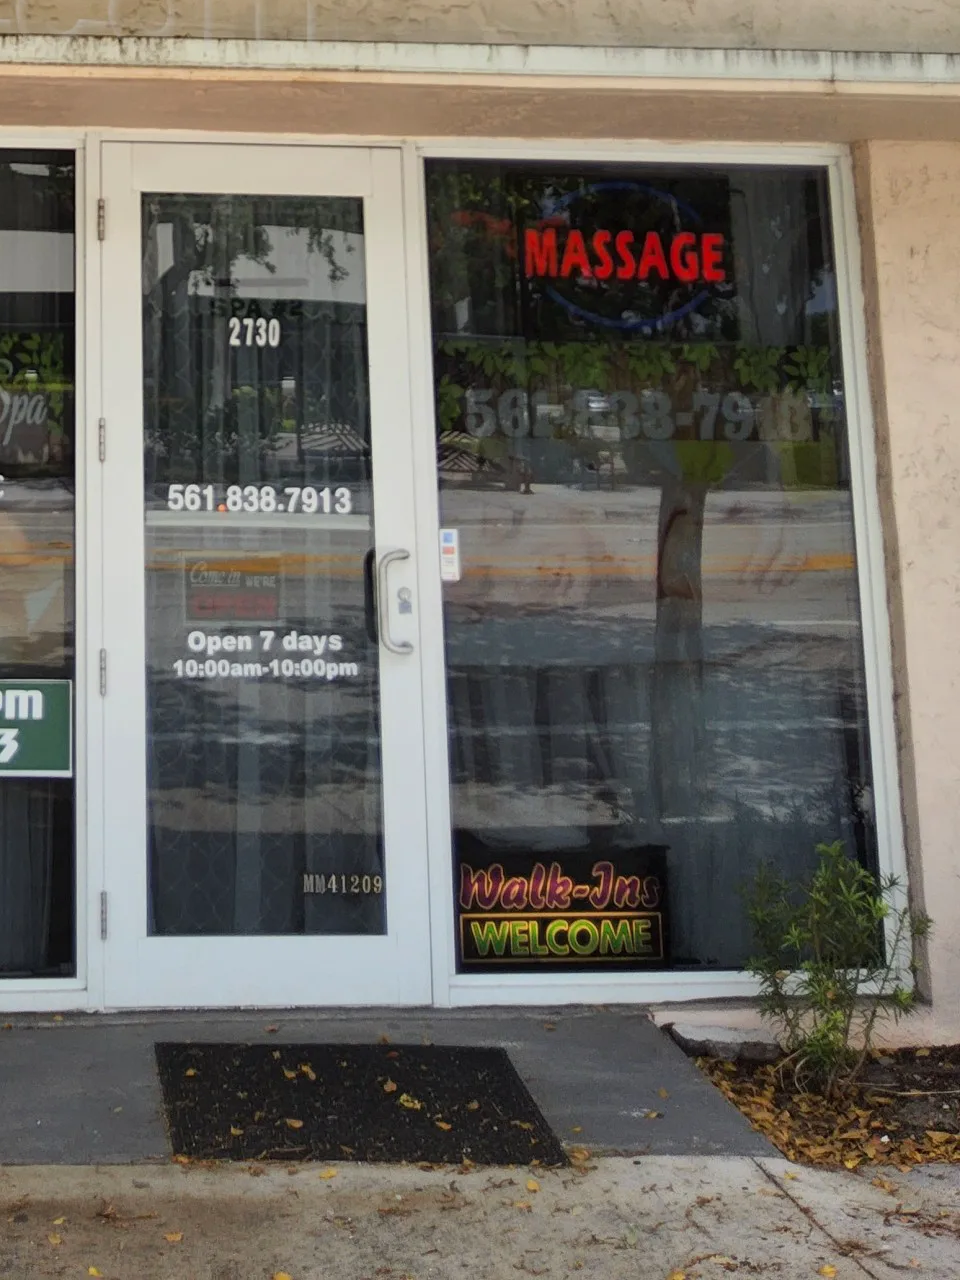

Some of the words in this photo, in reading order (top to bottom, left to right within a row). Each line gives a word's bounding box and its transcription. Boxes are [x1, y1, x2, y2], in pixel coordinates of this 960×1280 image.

[524, 227, 726, 283] MASSAGE
[229, 318, 281, 347] 2730
[167, 483, 353, 515] 561.838.7913
[187, 629, 253, 656] Open
[259, 629, 276, 651] 7
[282, 630, 343, 656] days
[172, 659, 358, 681] 10:00am-10:00pm
[303, 872, 384, 895] MM41209
[458, 861, 662, 910] Walk-Ins
[470, 918, 653, 957] WELCOME
